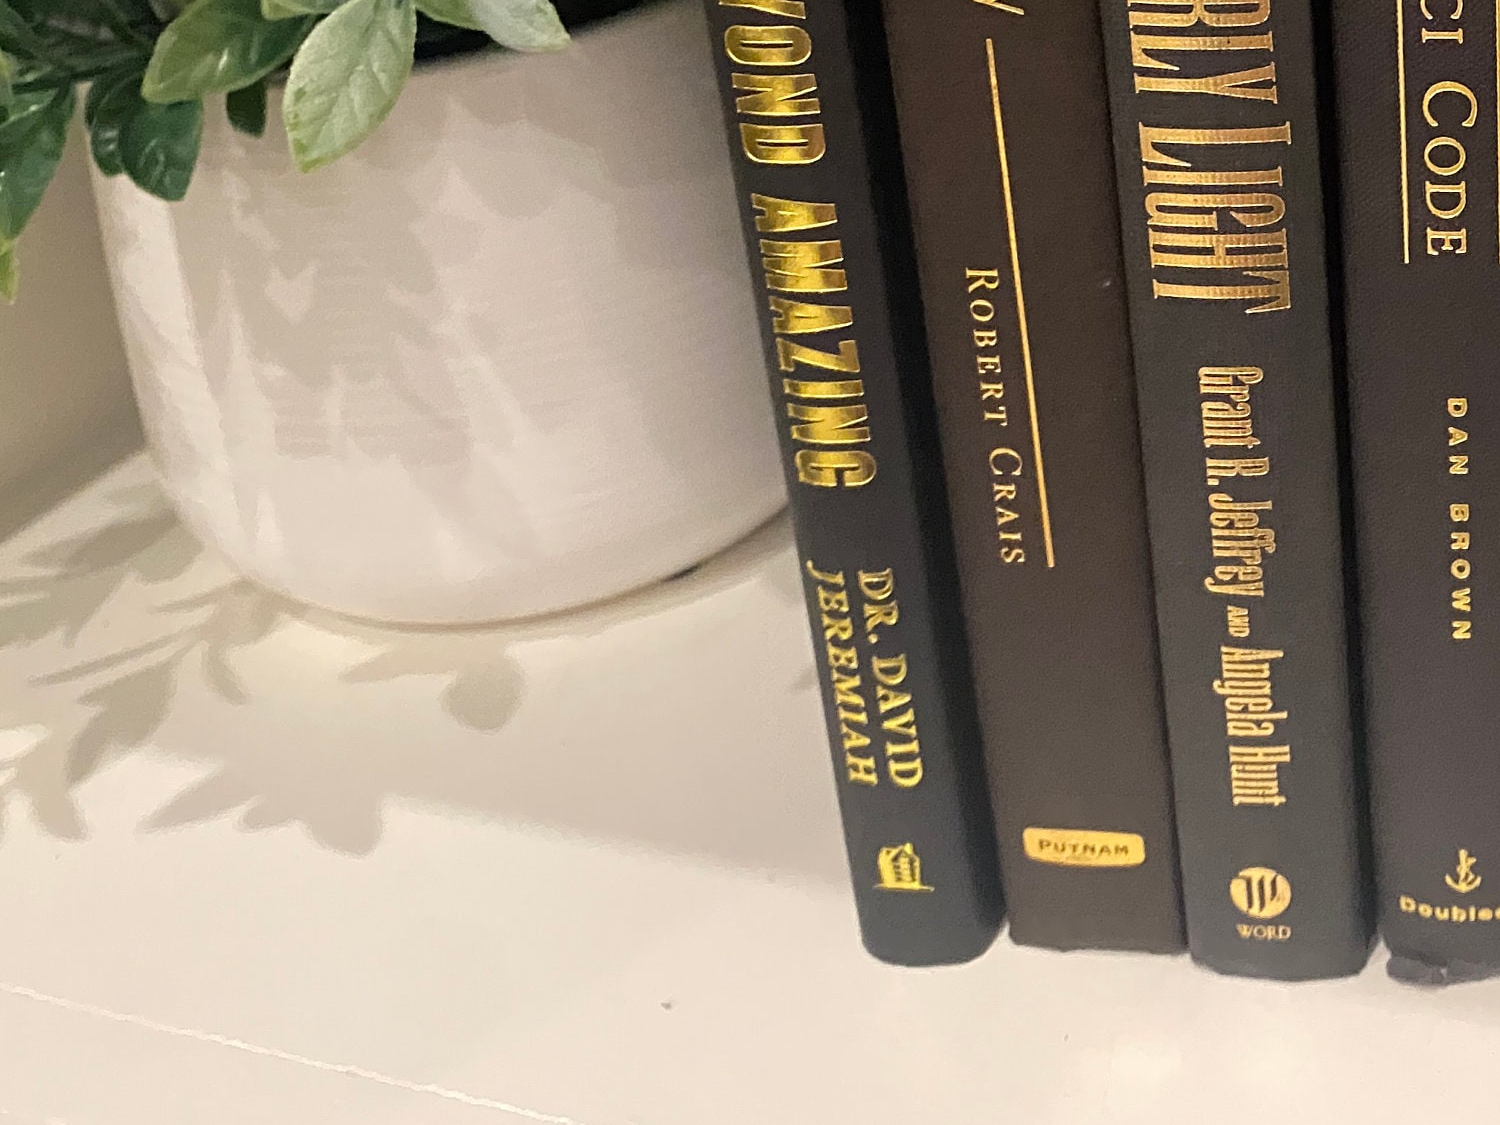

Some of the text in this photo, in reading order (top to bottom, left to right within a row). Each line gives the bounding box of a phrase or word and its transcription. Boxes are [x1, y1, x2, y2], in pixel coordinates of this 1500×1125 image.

[1139, 122, 1291, 313] LIGHT
[1423, 81, 1477, 255] CODE
[751, 193, 876, 489] AMAZING
[966, 268, 1025, 563] ROBERT CRAIS
[1198, 367, 1290, 806] Grant R. Jeffrey AND Angela Hunt
[1448, 398, 1471, 639] DAN BROWN
[806, 560, 878, 786] JEREMIAH
[858, 568, 923, 788] DR. DAVID
[1039, 838, 1129, 856] PUTNAM
[1237, 924, 1291, 940] WORD
